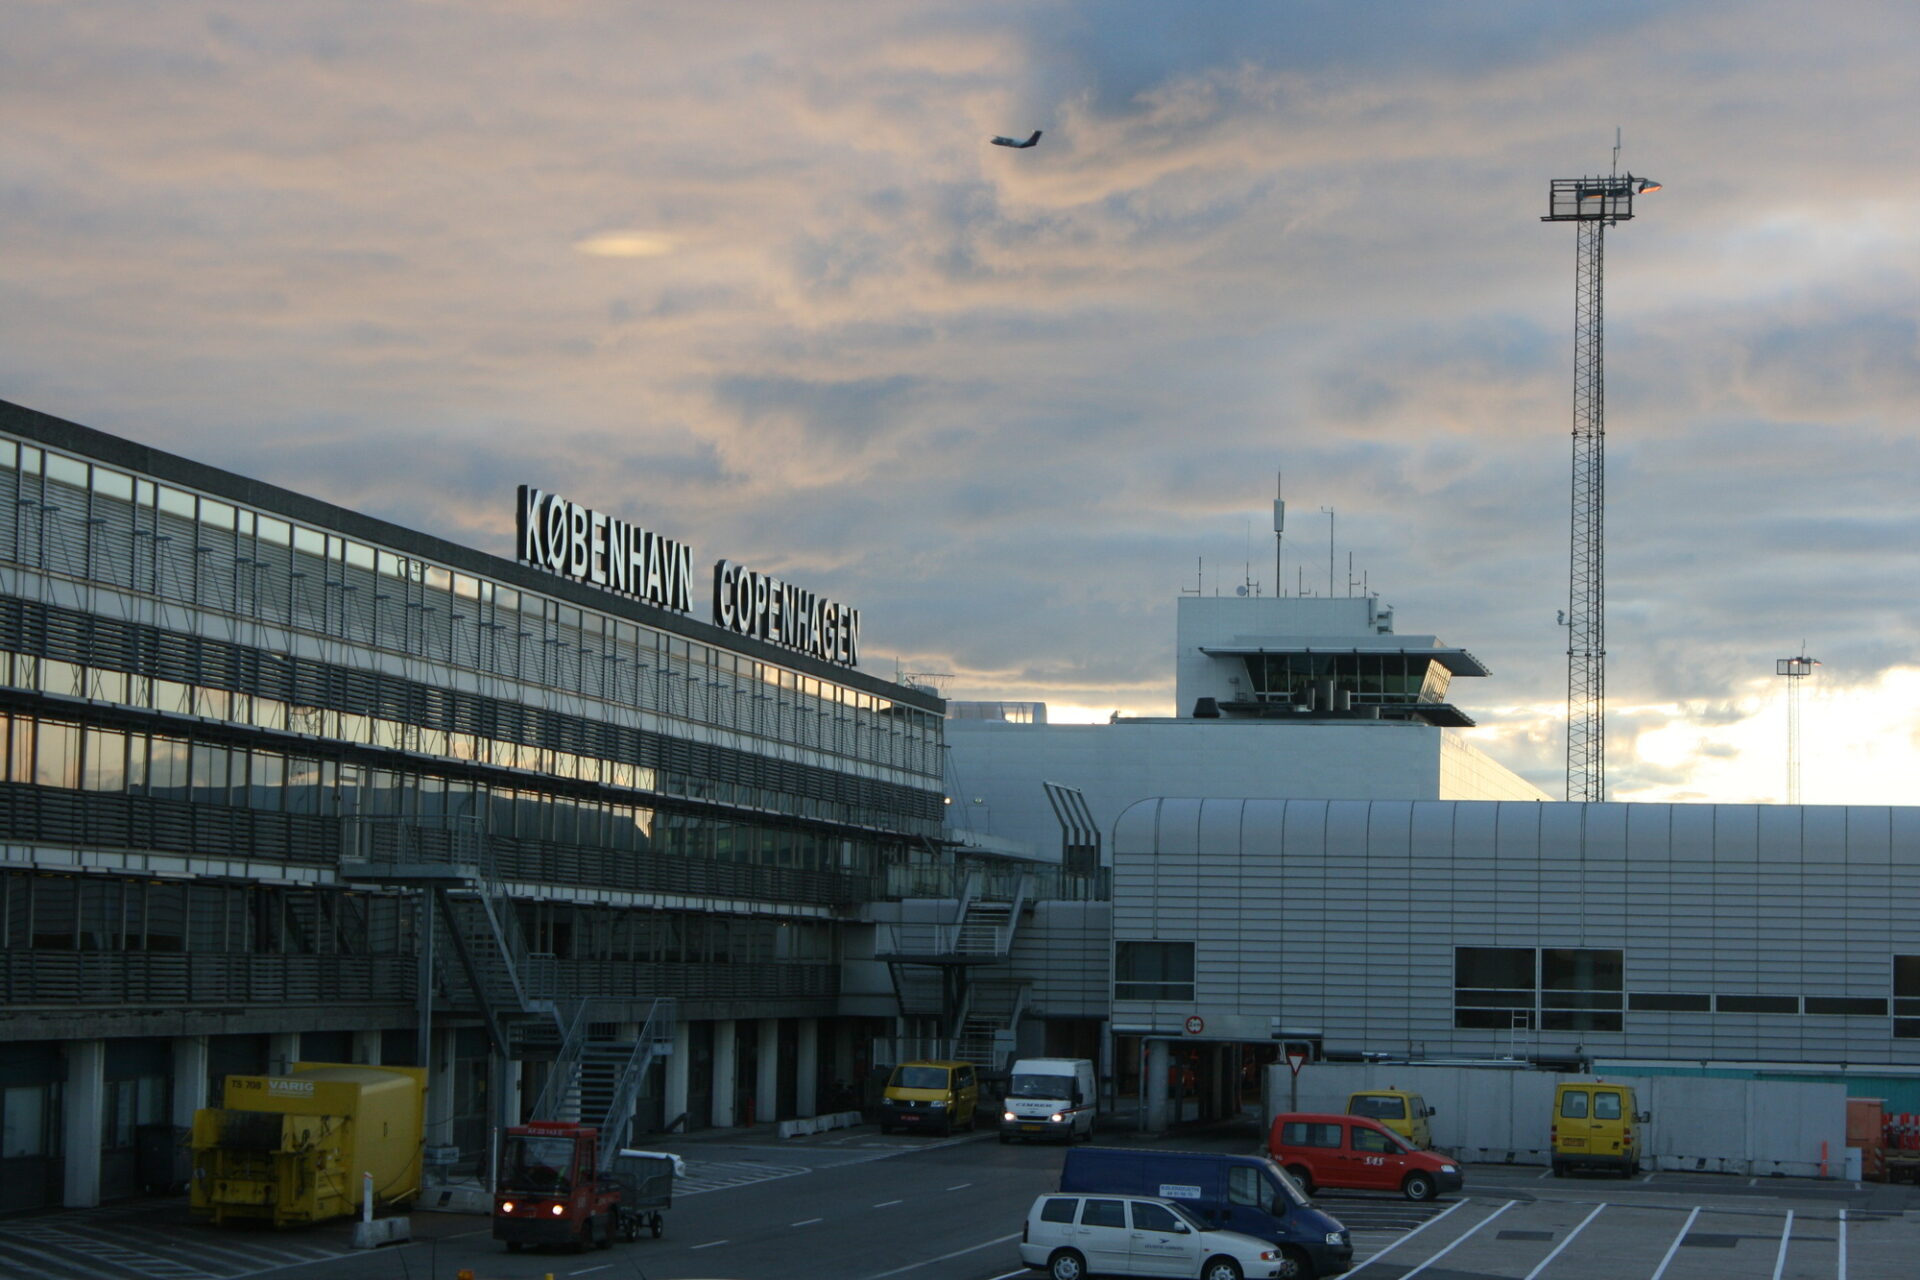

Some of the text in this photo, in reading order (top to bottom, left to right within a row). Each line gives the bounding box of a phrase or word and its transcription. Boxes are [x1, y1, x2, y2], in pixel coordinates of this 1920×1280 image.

[518, 485, 693, 613] KØBENHAVN
[715, 559, 861, 666] COPENHAGEN
[269, 1080, 314, 1091] VARIG
[1364, 1156, 1385, 1165] SAS
